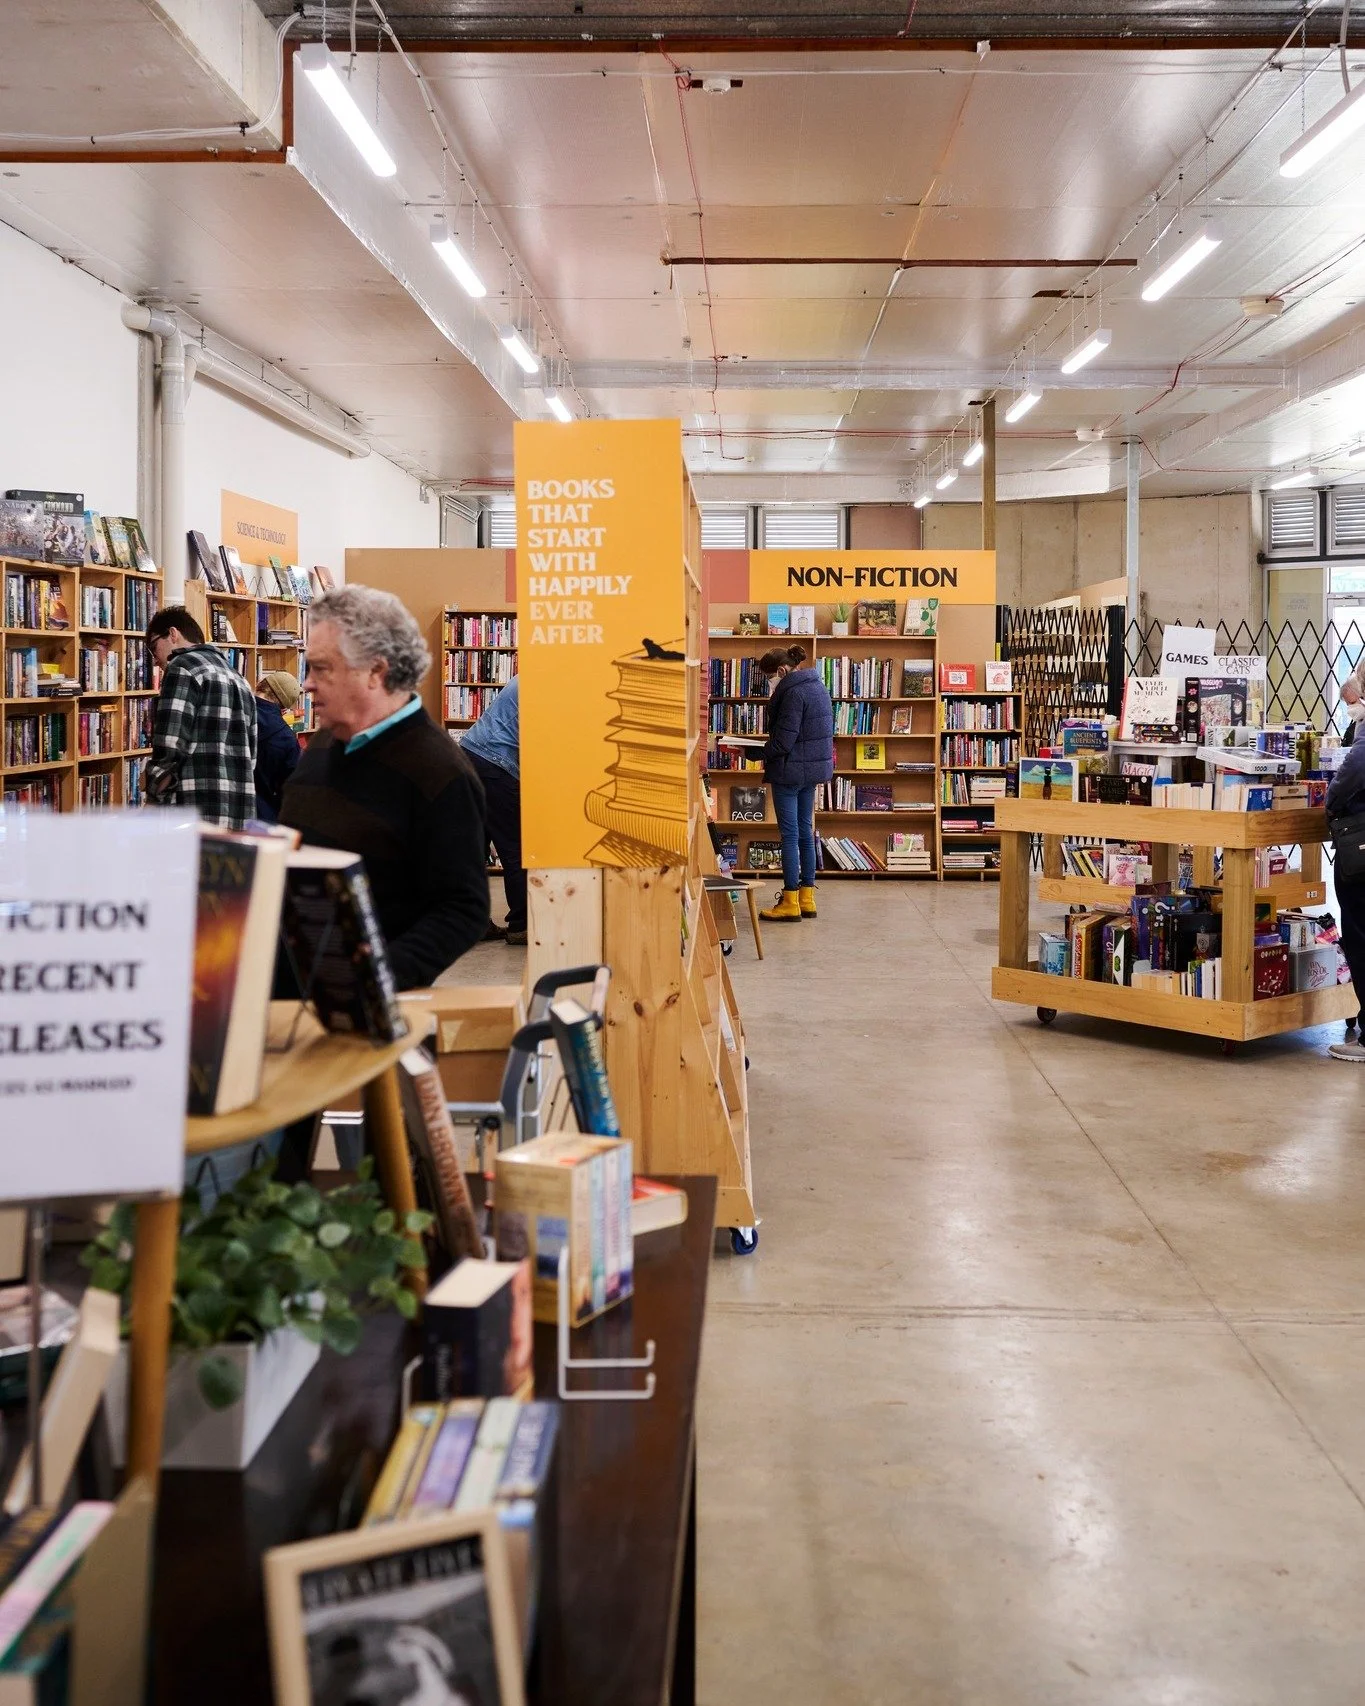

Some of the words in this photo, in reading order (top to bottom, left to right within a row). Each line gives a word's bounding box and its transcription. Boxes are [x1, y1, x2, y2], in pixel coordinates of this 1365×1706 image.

[527, 479, 615, 500] BOOKS
[527, 503, 593, 524] THAT
[237, 521, 255, 538] SCIENCE
[260, 528, 286, 545] TECHNOLOGY
[527, 527, 606, 548] START
[528, 552, 596, 572] WITH
[529, 575, 632, 596] HAPPILY
[787, 567, 958, 588] NON-FICTION
[529, 601, 594, 621] EVER
[530, 624, 604, 645] AFTER
[1166, 652, 1209, 666] GAMES
[1219, 657, 1259, 667] CLASSIC
[1226, 664, 1251, 675] CATS
[1123, 764, 1153, 776] MAGIC
[0, 901, 149, 932] ICTION
